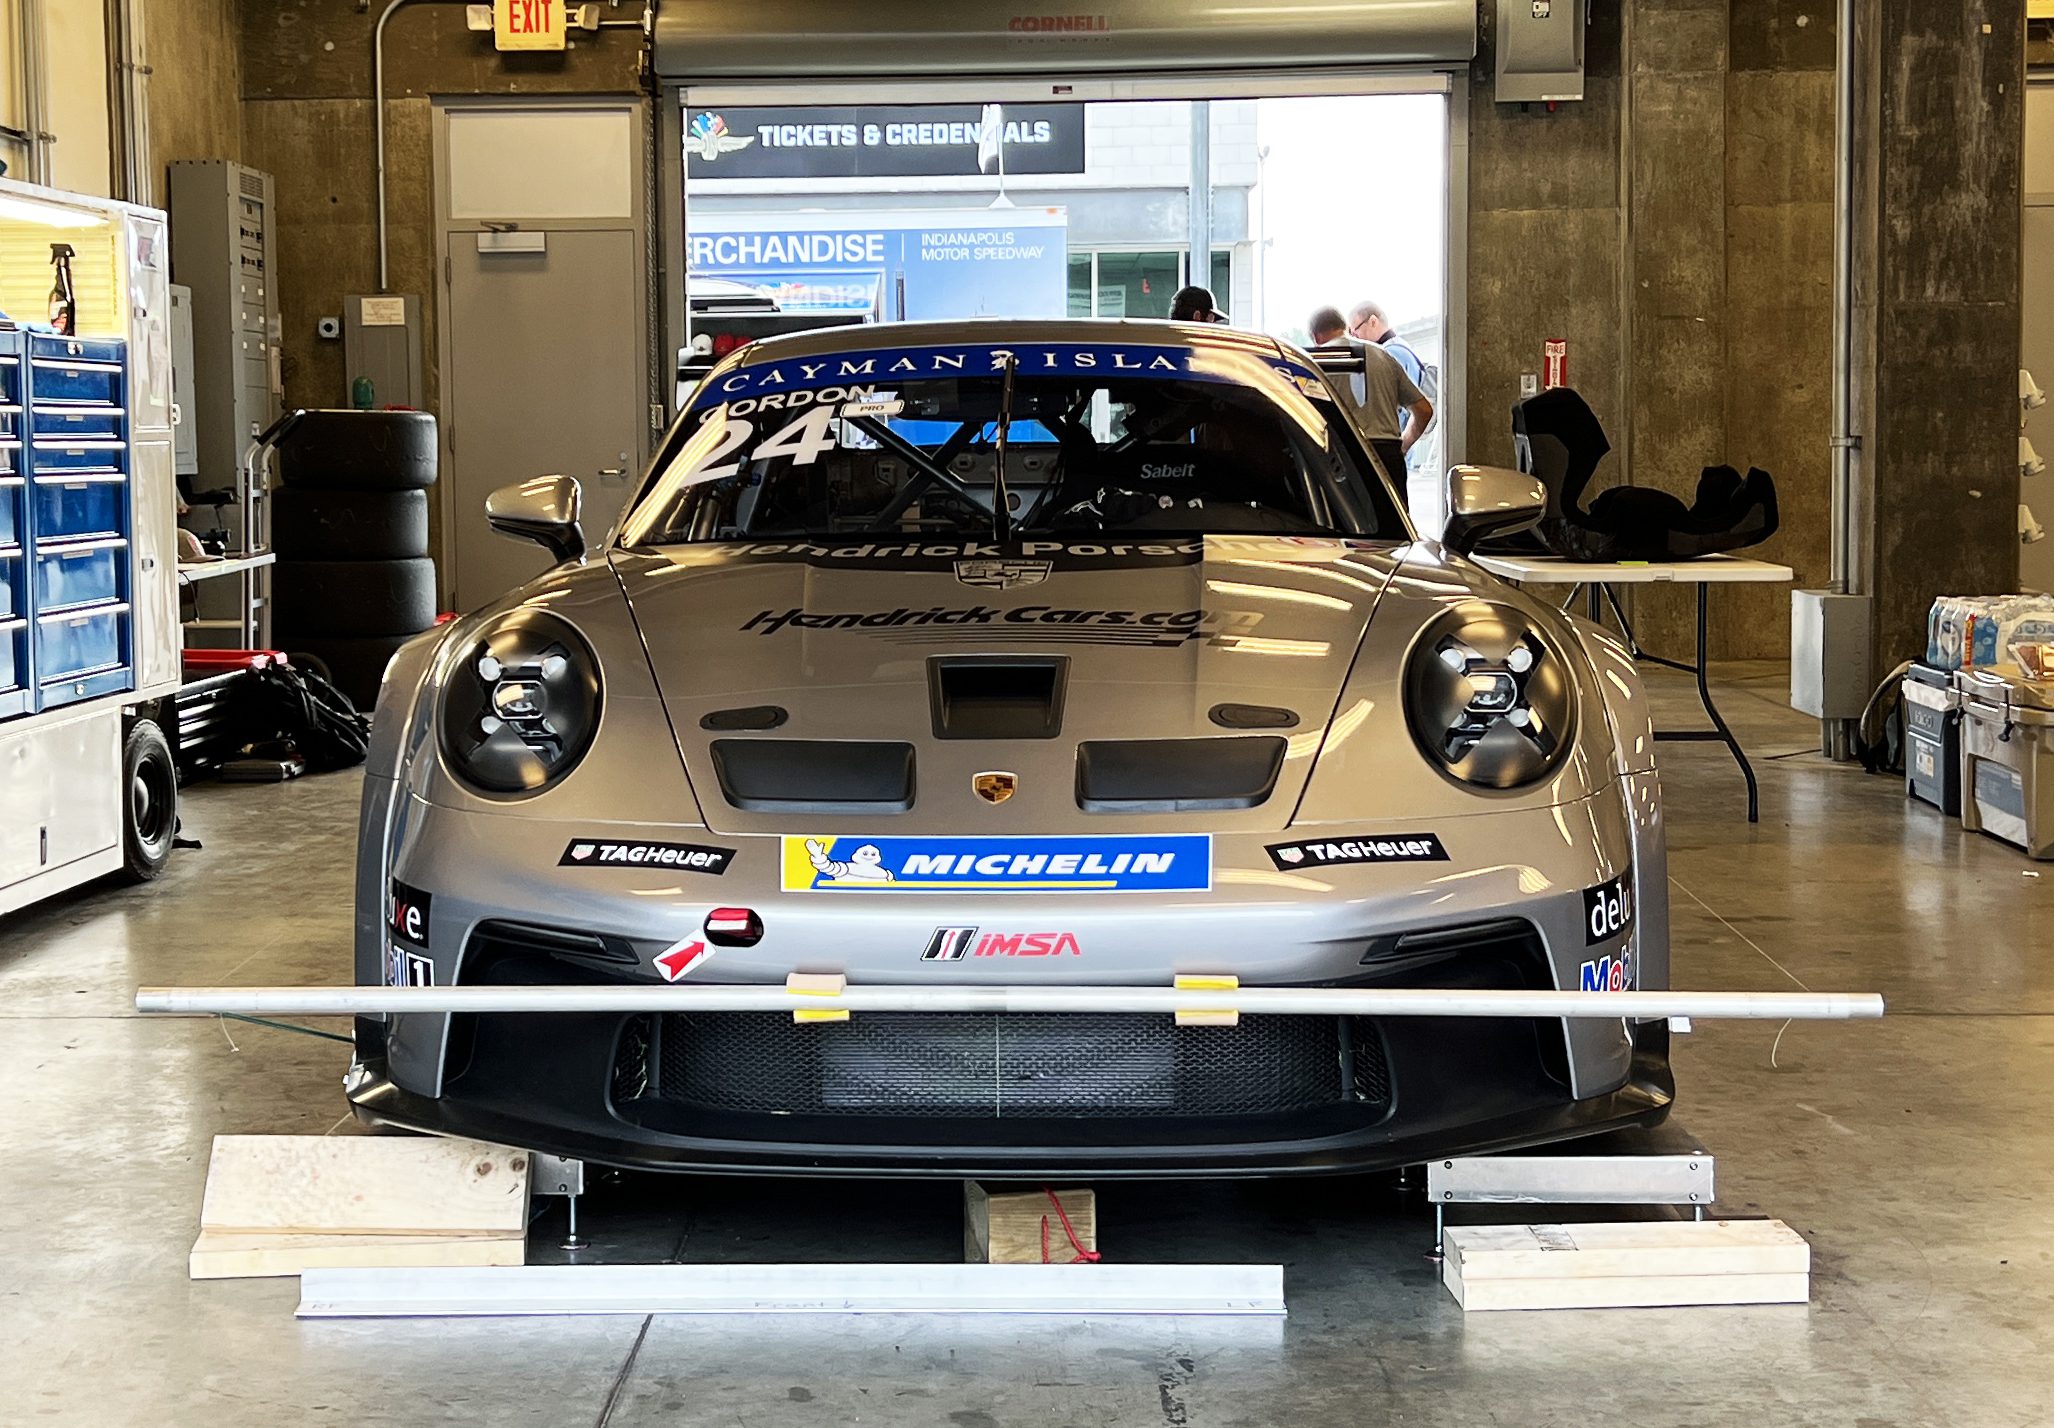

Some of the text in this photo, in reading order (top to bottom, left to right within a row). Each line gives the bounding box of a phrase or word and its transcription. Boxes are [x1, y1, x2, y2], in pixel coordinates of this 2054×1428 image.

[509, 0, 552, 33] EXIT
[757, 121, 1051, 147] TICKETS & CREDENALS
[688, 234, 885, 265] RCHANDISE
[921, 232, 1014, 246] INDIANAPOLIS
[921, 246, 1046, 261] MOTOR SPEEDWAY
[1546, 345, 1565, 354] FIRE
[722, 352, 1297, 392] CAYMAN ISLAS
[674, 405, 837, 489] 24
[1140, 463, 1196, 479] Sabelt
[703, 542, 1000, 558] Hendrick
[901, 853, 1176, 875] MICHELIN
